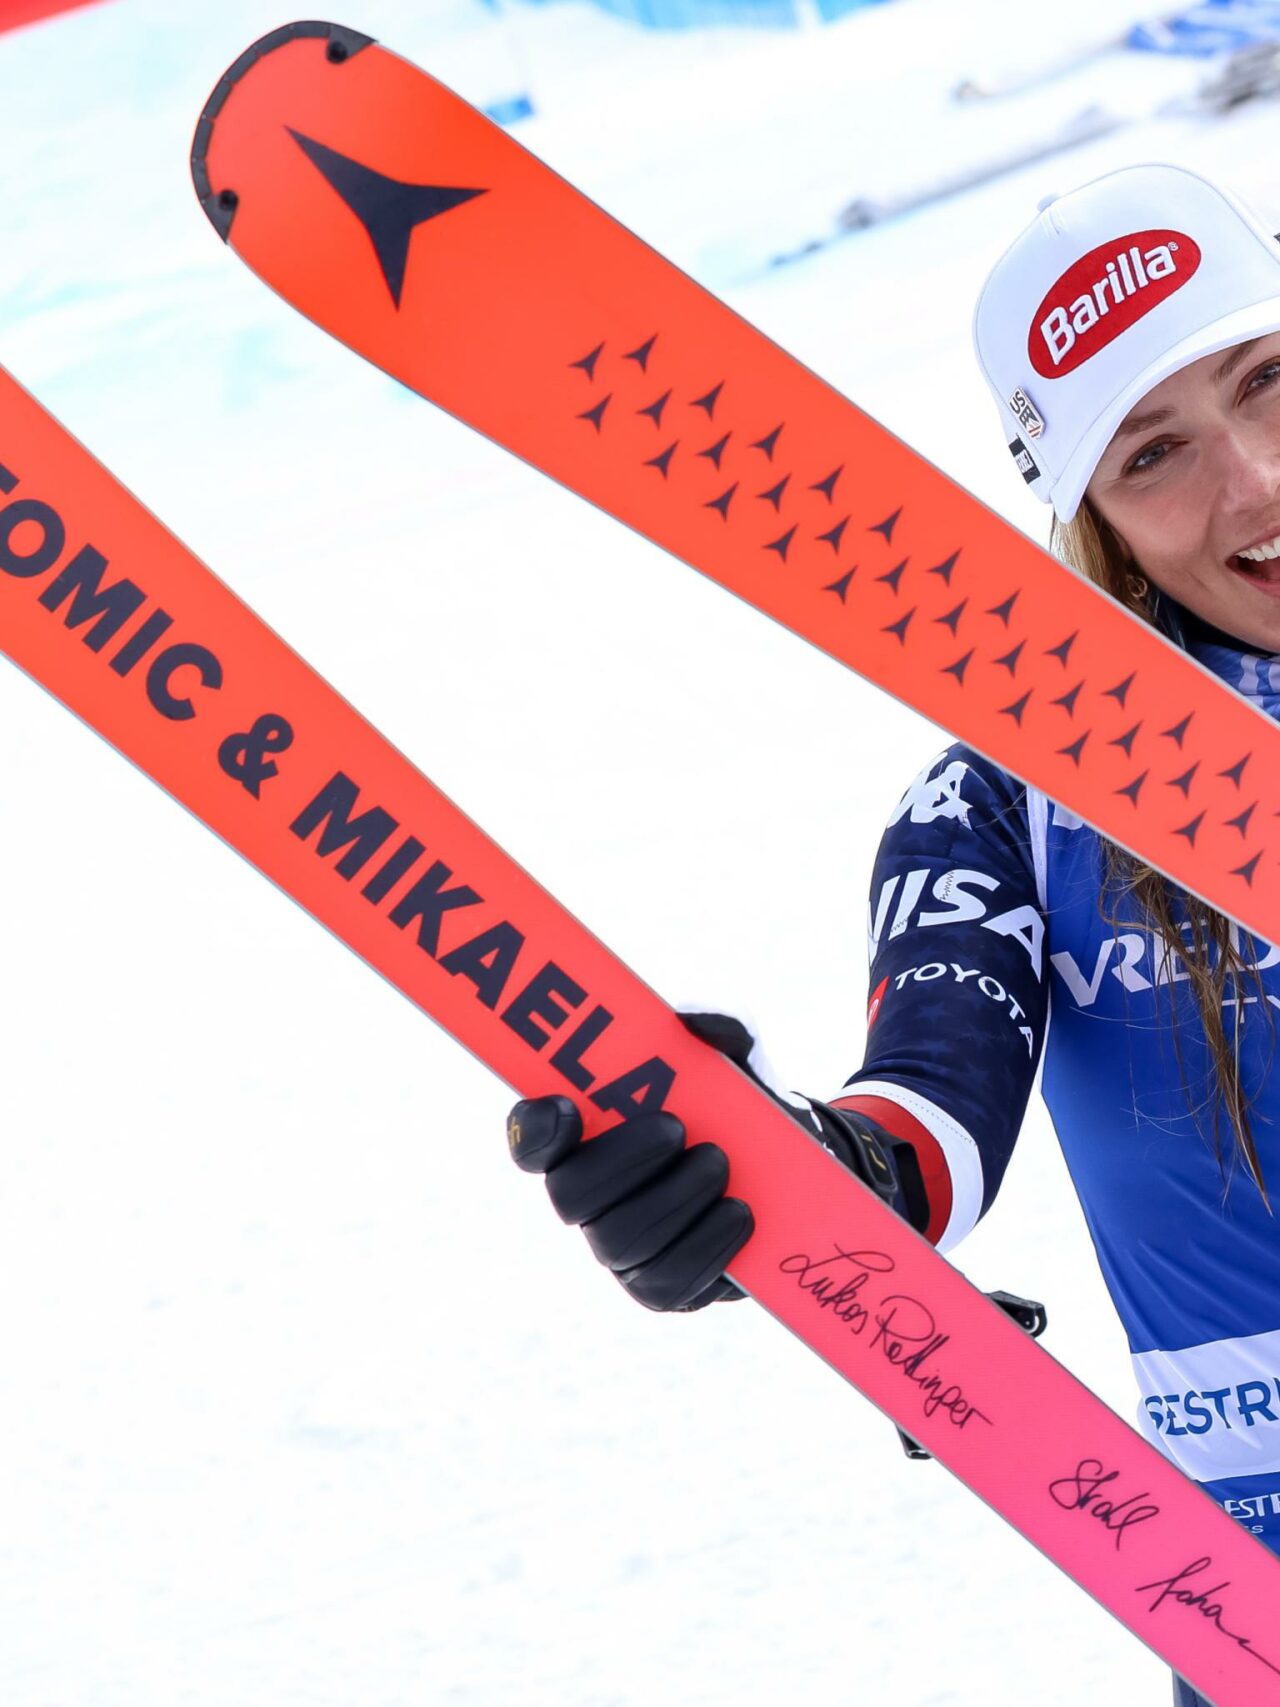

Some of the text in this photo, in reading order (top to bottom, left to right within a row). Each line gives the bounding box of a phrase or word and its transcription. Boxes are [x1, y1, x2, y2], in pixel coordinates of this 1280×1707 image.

[1040, 245, 1177, 366] Barilla
[0, 463, 677, 1122] OMIC & MIKAELA
[867, 868, 1045, 984] VISA
[895, 962, 1033, 1059] TOYOTA
